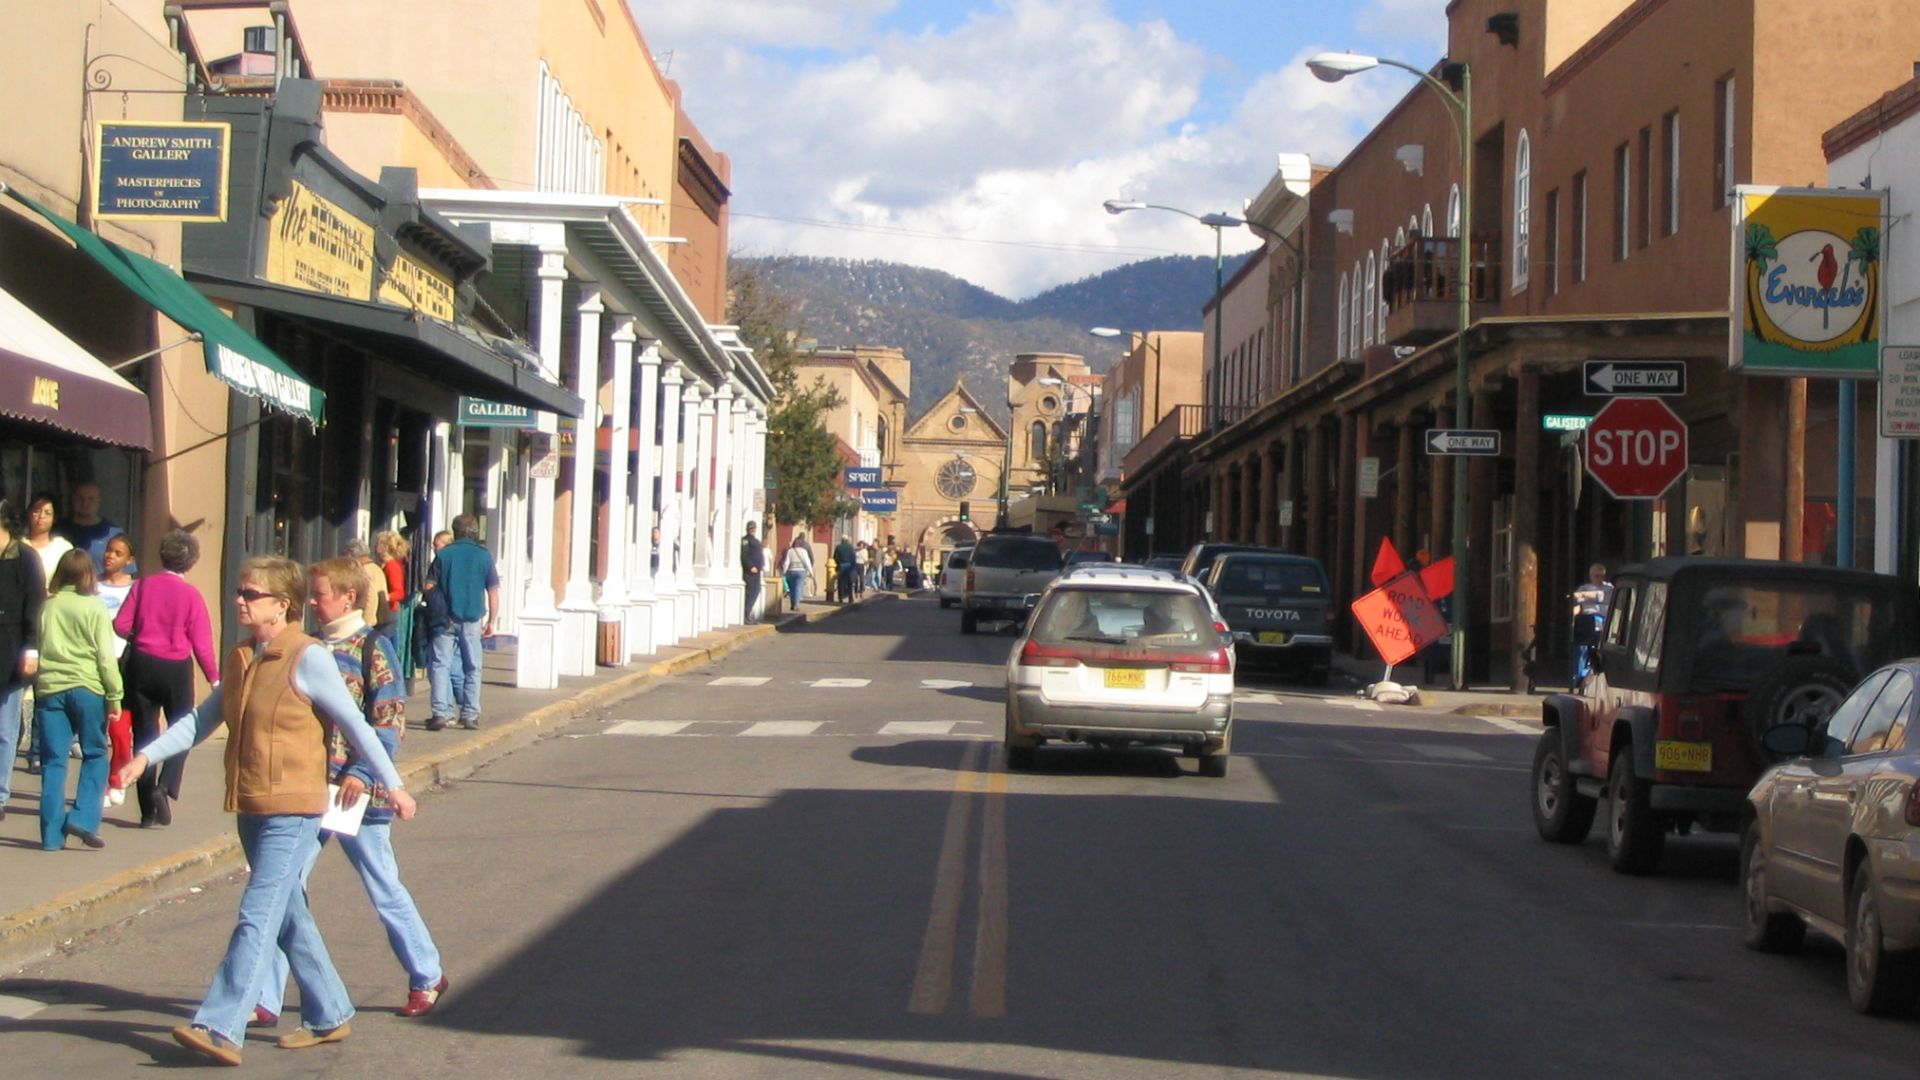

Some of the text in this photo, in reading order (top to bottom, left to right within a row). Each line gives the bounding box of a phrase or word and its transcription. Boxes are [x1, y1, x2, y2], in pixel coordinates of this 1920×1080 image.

[112, 137, 212, 149] ANDREW SMITH
[132, 149, 191, 160] GALLERY
[117, 177, 201, 187] MASTERPIECES
[116, 198, 201, 209] PHOTOGRAPHY
[1614, 373, 1674, 384] ONE WAY
[469, 403, 528, 416] GALLERY
[1546, 417, 1586, 430] GALISTEO
[1448, 438, 1491, 447] ONE WAY
[1593, 429, 1680, 466] STOP
[848, 472, 877, 482] SPIRIT
[1246, 608, 1300, 621] TOYOTA
[1375, 625, 1423, 645] AHEAD
